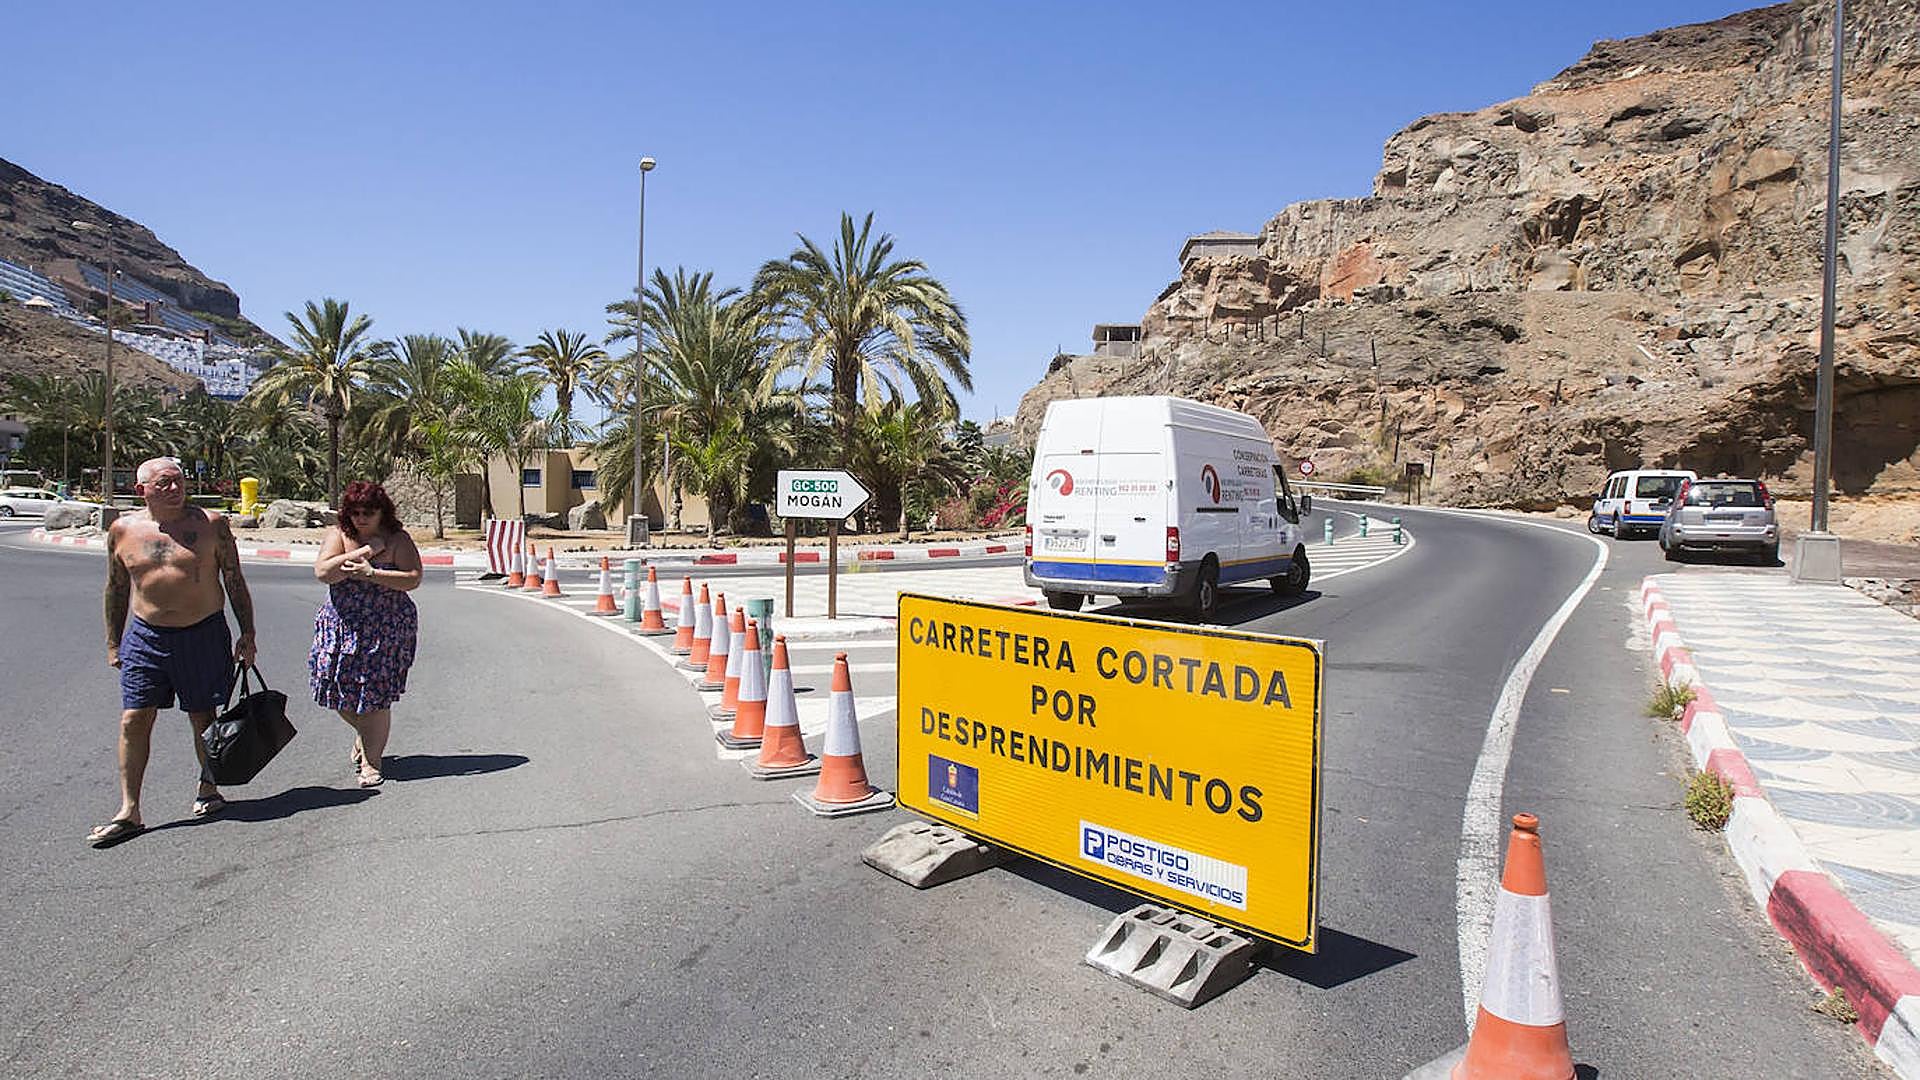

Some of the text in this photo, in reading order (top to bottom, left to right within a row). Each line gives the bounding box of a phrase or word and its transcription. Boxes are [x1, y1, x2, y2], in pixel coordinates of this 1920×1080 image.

[1074, 486, 1118, 496] RENTING
[909, 617, 1292, 709] CARRETERA CORTADA
[1031, 685, 1097, 728] POR
[921, 706, 1263, 822] DESPRENDIMIENTOS
[1107, 834, 1189, 871] POSTIGO
[1107, 852, 1243, 904] OBRAS Y SERVICIOS
